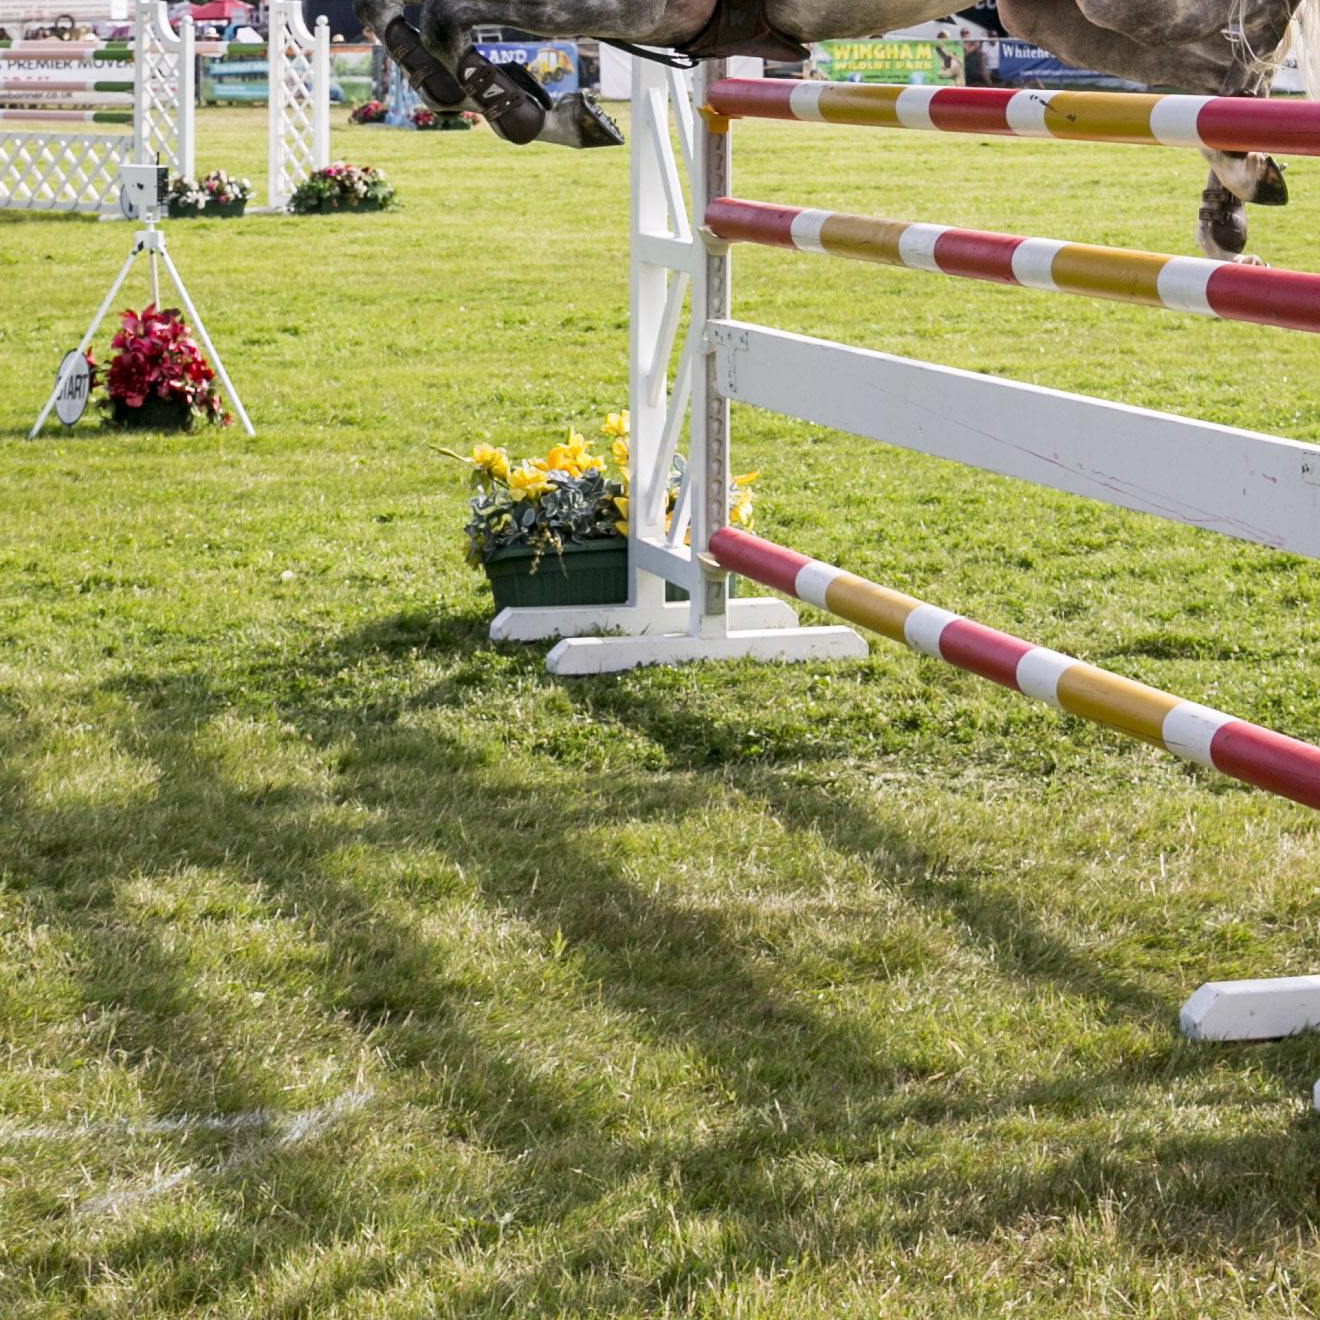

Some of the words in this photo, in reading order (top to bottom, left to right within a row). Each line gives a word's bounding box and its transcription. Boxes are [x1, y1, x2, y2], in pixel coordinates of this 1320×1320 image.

[833, 42, 933, 60] WINGHAM
[1001, 42, 1056, 59] Whitehe
[7, 59, 72, 71] PREMIER
[896, 60, 933, 70] PARK
